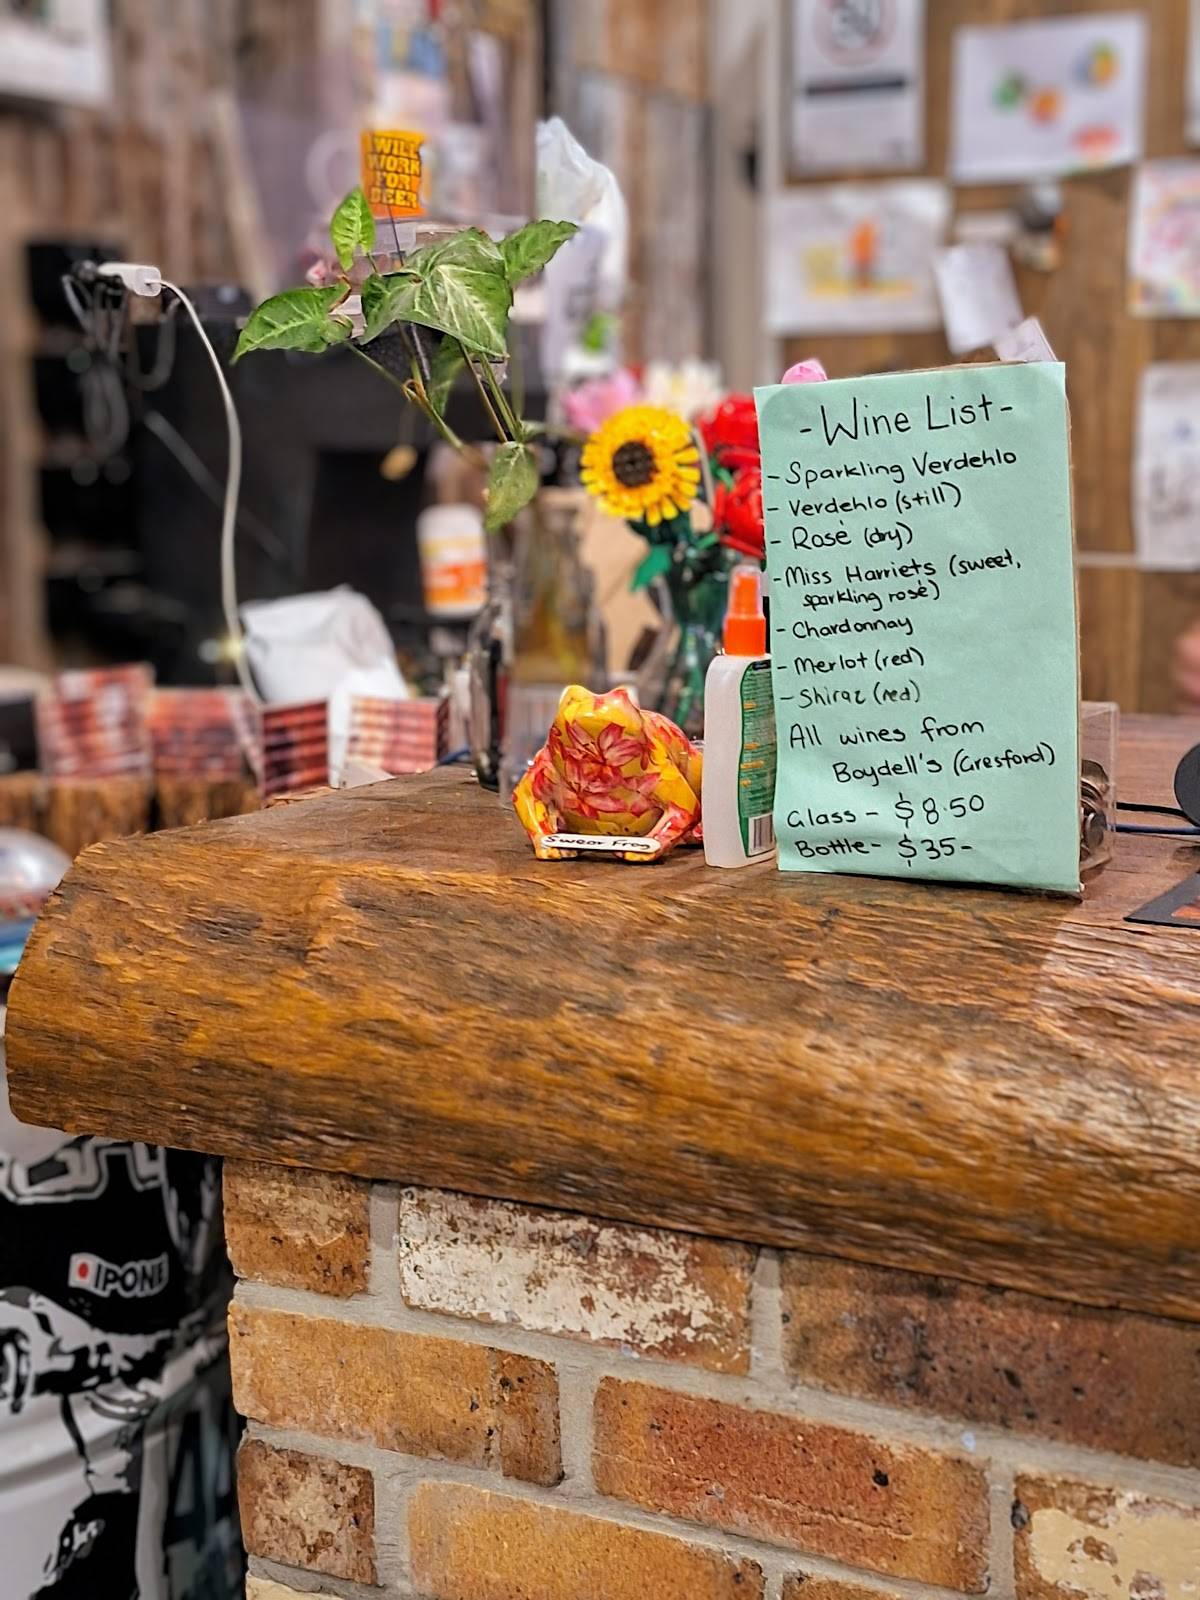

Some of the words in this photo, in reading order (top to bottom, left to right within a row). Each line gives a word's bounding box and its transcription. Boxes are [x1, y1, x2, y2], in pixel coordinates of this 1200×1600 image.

[373, 136, 420, 160] WILL
[367, 153, 421, 176] WORK
[374, 170, 411, 191] FOR
[912, 448, 1017, 477] Verdehlo
[895, 482, 962, 515] (still)
[863, 522, 913, 551] (dry)
[948, 547, 1022, 578] (sweet,
[802, 587, 884, 612] sparkling
[874, 646, 925, 672] (red)
[872, 679, 921, 706] (red)
[789, 722, 823, 750] All
[839, 726, 907, 746] wines
[920, 716, 985, 742] from
[832, 752, 943, 787] Boydell's
[786, 808, 857, 828] Glass
[611, 838, 651, 850] Frog
